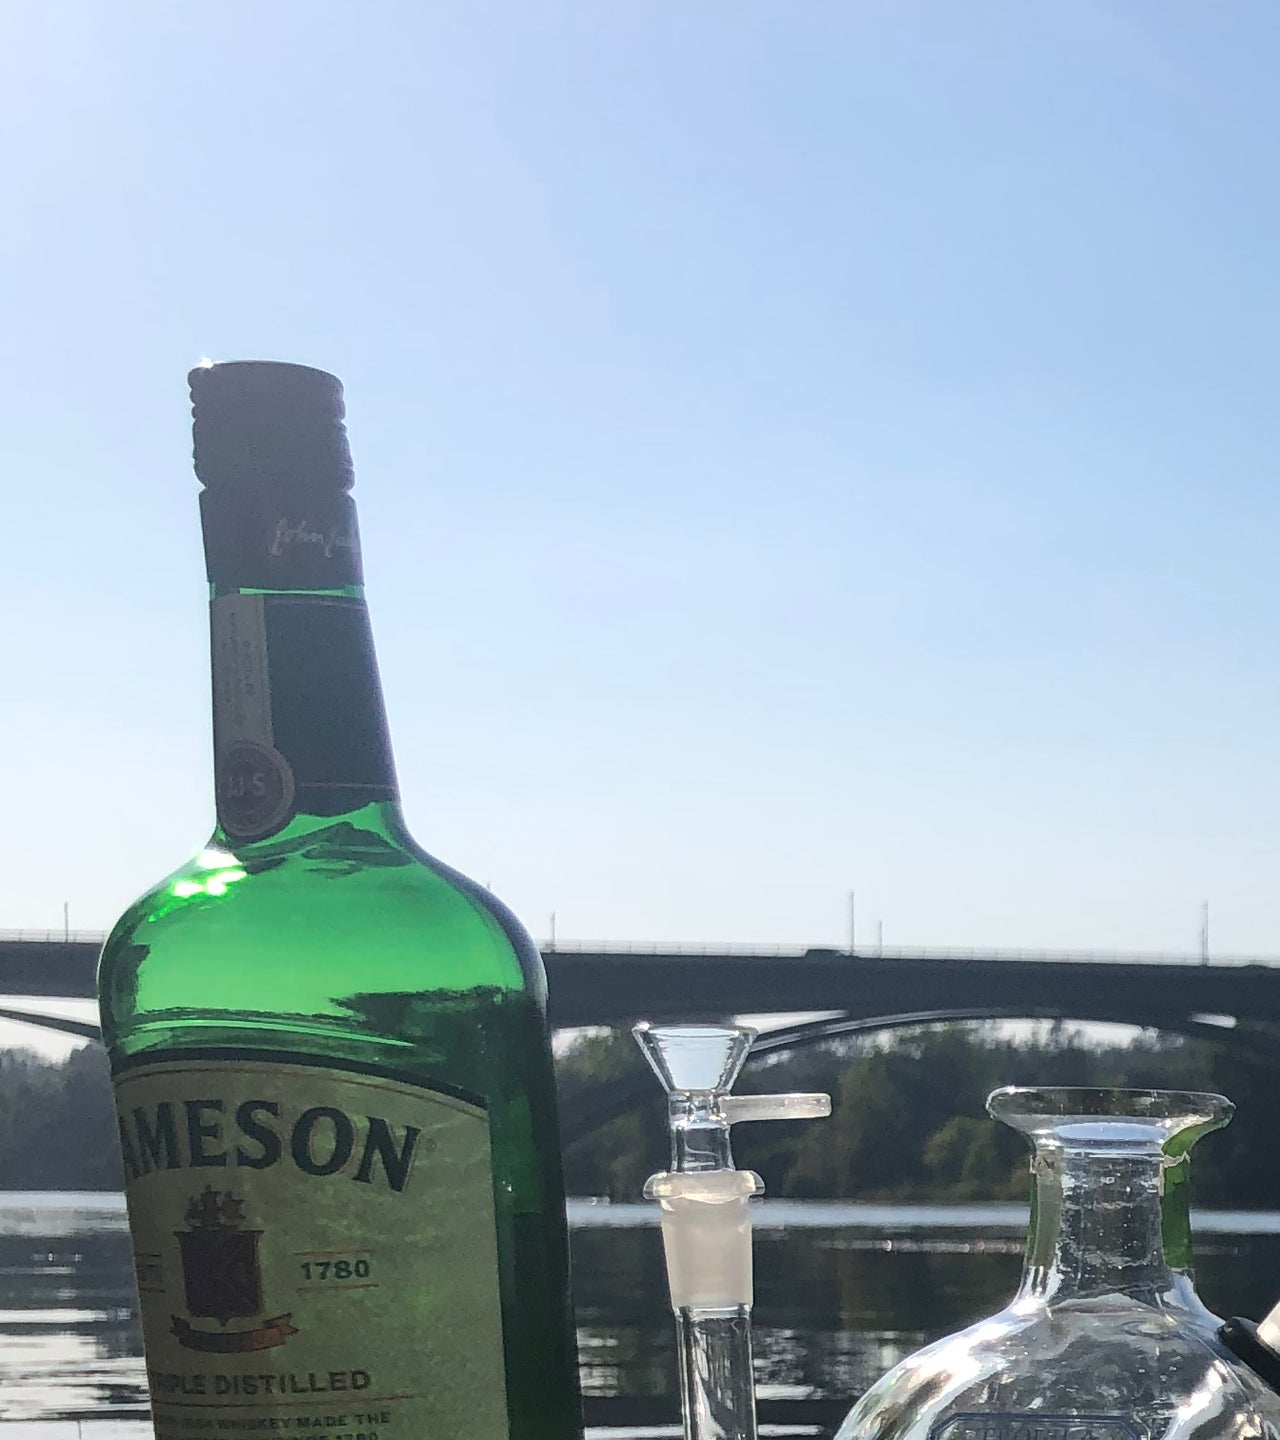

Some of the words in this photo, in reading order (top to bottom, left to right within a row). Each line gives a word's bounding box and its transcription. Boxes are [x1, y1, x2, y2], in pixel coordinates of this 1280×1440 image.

[300, 1259, 370, 1281] 1780
[215, 1370, 372, 1396] DISTILLED
[296, 1416, 348, 1429] MADE
[355, 1412, 391, 1425] THE
